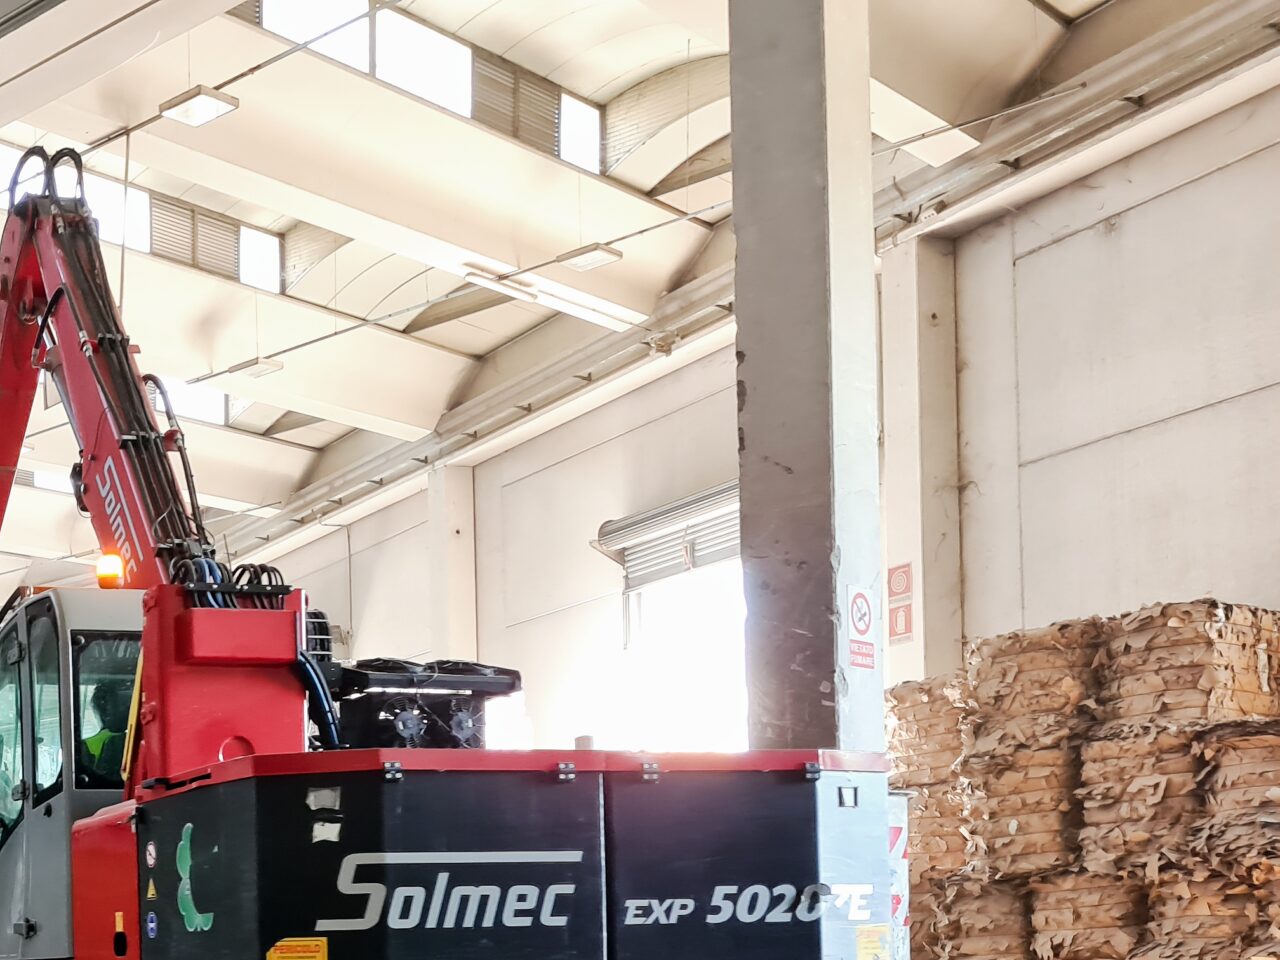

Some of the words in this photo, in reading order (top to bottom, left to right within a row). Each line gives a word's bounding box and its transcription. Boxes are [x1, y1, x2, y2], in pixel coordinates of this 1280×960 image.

[96, 456, 143, 583] Solmec
[315, 850, 584, 931] Solmec
[624, 898, 695, 925] EXP
